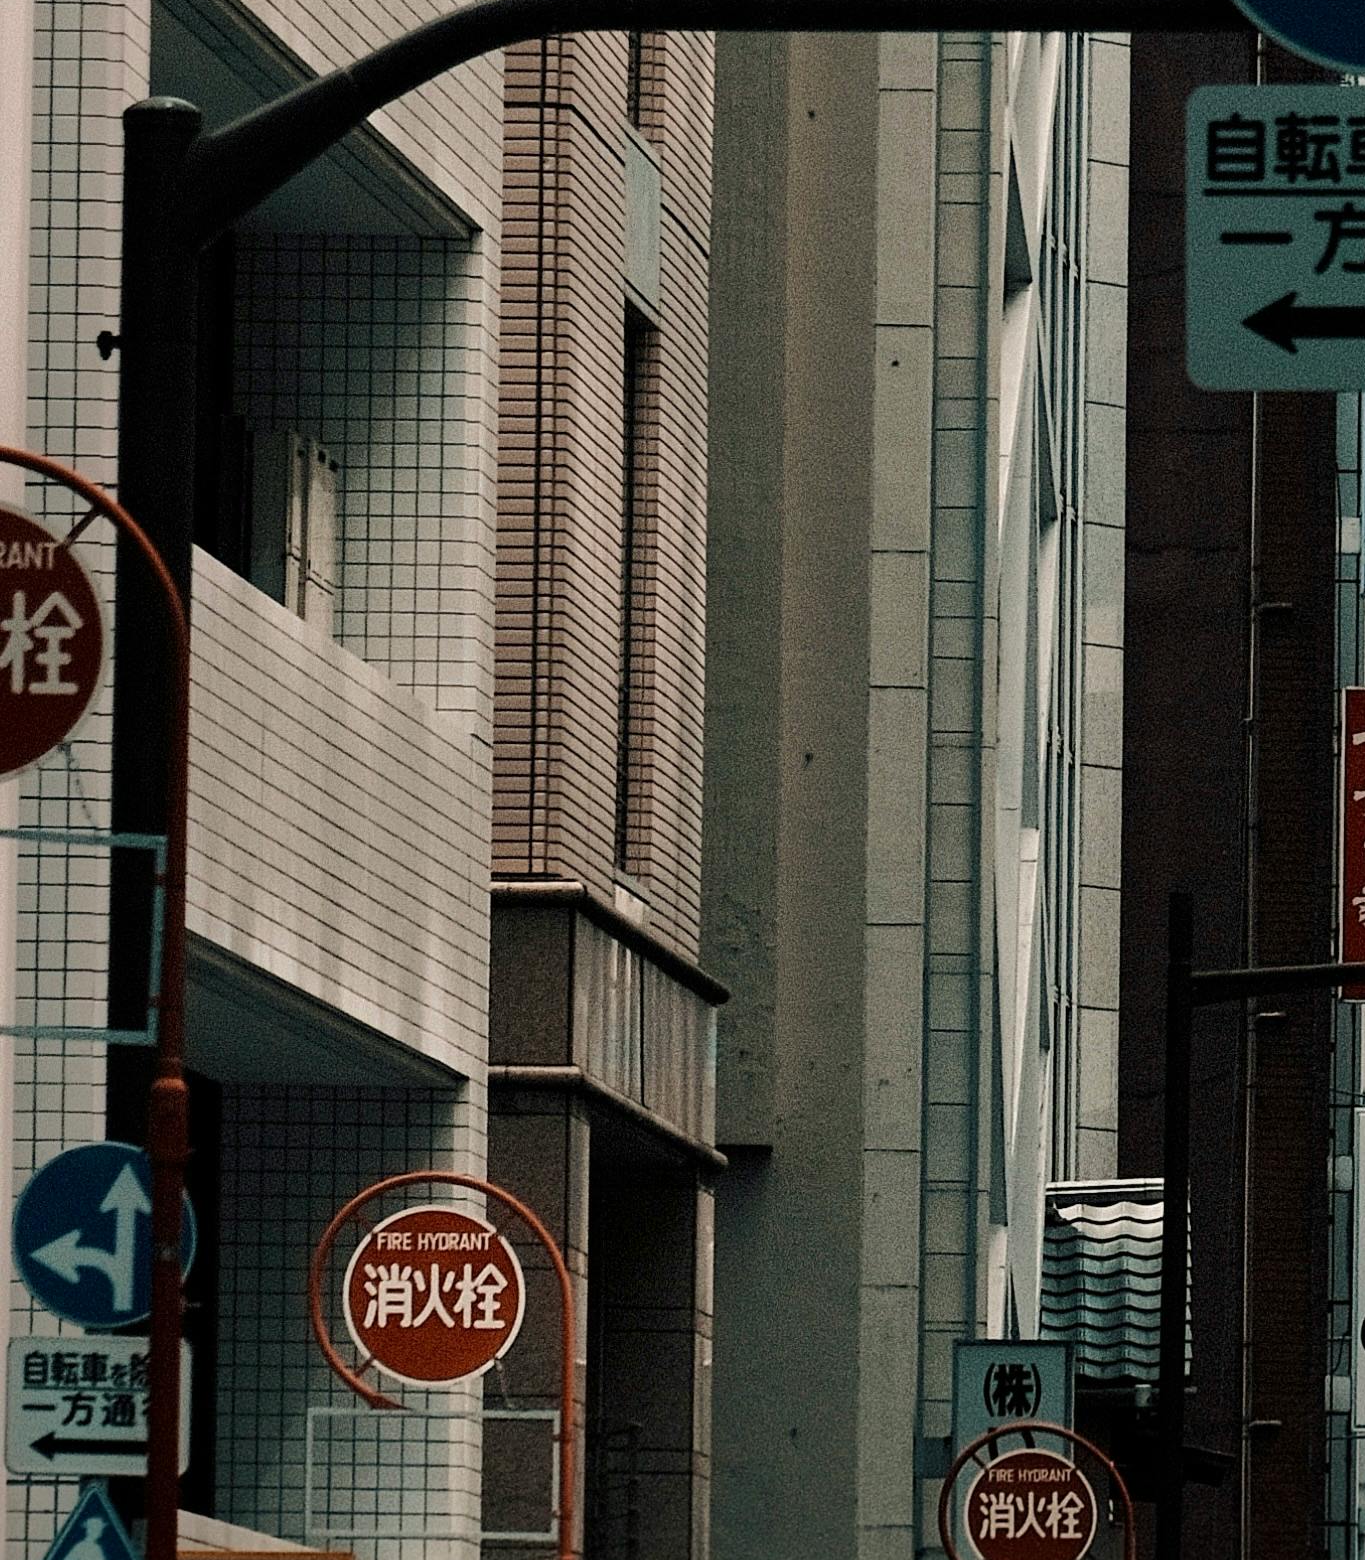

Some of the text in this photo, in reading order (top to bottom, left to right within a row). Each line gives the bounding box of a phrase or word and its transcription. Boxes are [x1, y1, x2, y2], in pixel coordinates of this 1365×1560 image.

[377, 1232, 493, 1251] FIRE HYDRANT
[363, 1263, 509, 1329] 消火栓
[22, 1352, 149, 1384] 自転車を除
[22, 1390, 149, 1427] 一方通
[988, 1469, 1073, 1483] FIRE HYDRANT
[979, 1490, 1085, 1540] 消火栓
